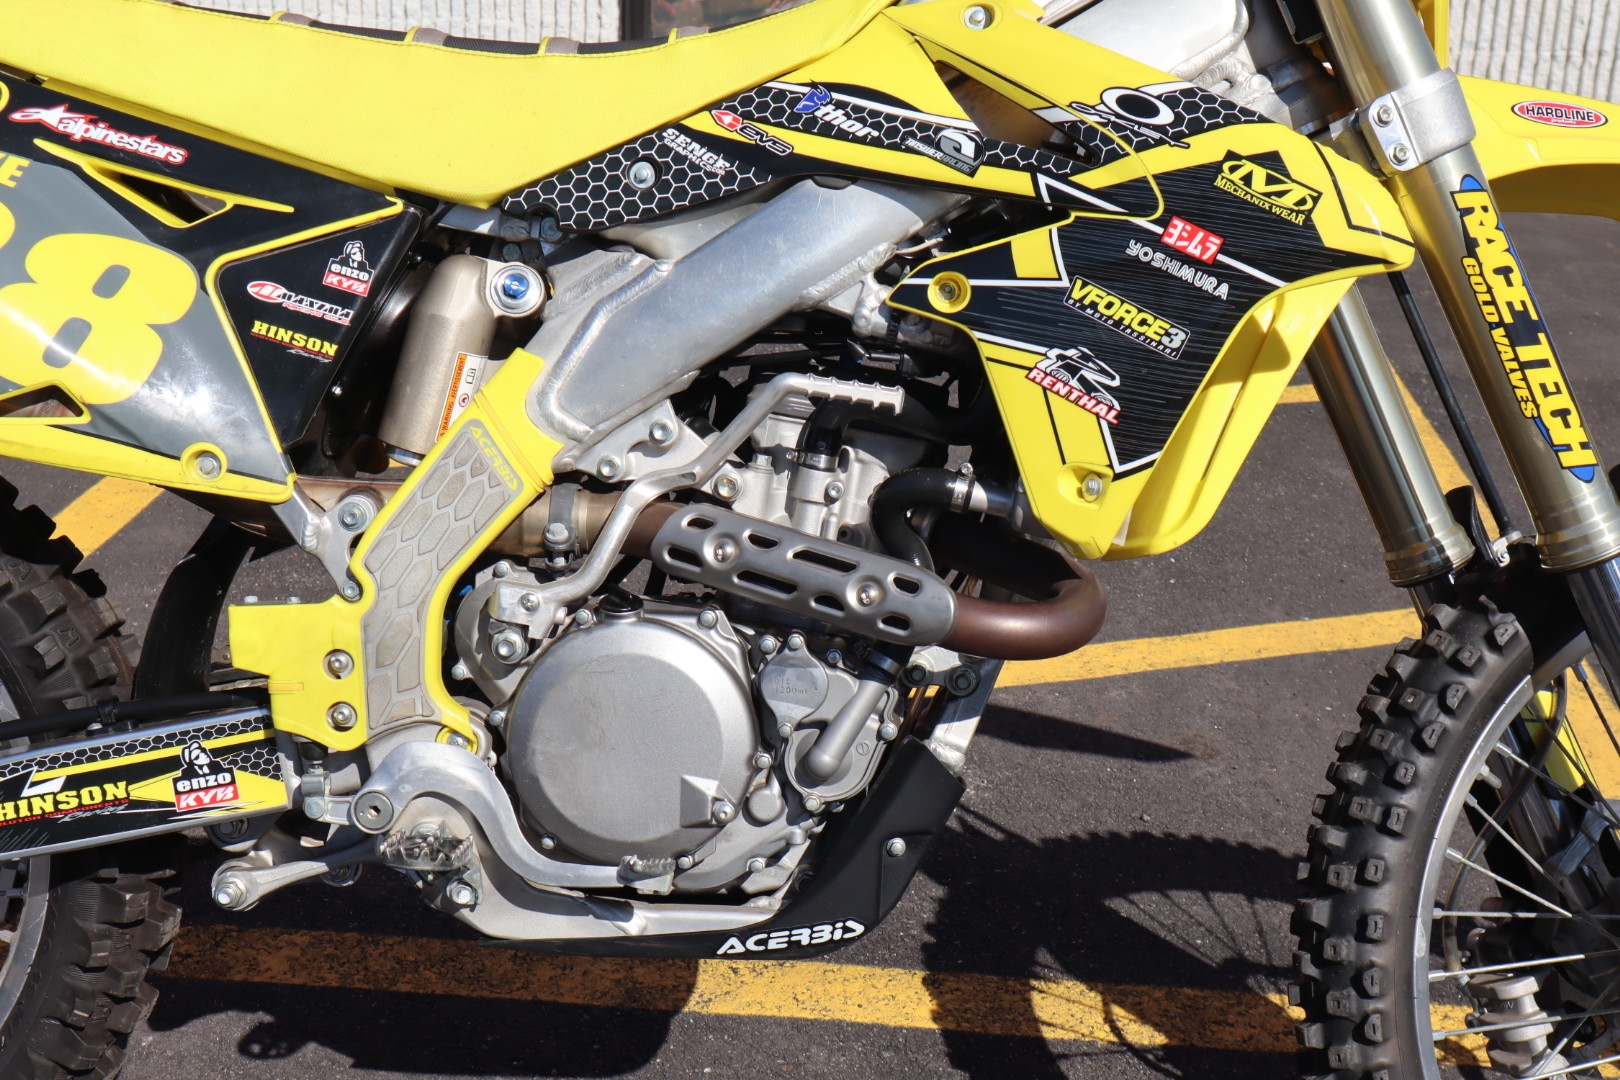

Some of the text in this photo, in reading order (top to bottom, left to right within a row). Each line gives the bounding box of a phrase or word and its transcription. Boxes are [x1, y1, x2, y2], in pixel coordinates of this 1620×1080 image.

[816, 102, 880, 139] thor
[1525, 105, 1595, 122] HARDLINE
[57, 118, 187, 163] alpinestars
[662, 128, 731, 169] SENGE
[739, 121, 793, 156] EVS
[0, 153, 31, 188] E
[1214, 174, 1307, 225] MECHANIX WEAR
[1163, 219, 1222, 261] ヨシムラ
[326, 273, 368, 293] KYB
[330, 263, 370, 281] enzo
[1125, 239, 1229, 300] YOSHIMURA
[1067, 299, 1178, 357] BY MOTO TASSINARI
[1068, 278, 1187, 349] VFORCE3
[1451, 190, 1599, 470] RACE TECH
[251, 320, 338, 357] HINSON
[1461, 256, 1539, 420] GOLD VALVES
[1028, 368, 1120, 424] RENTHAL
[0, 781, 129, 821] HINSON
[176, 772, 231, 792] enzo
[179, 786, 235, 808] KYB
[716, 920, 866, 956] ACERBIS
